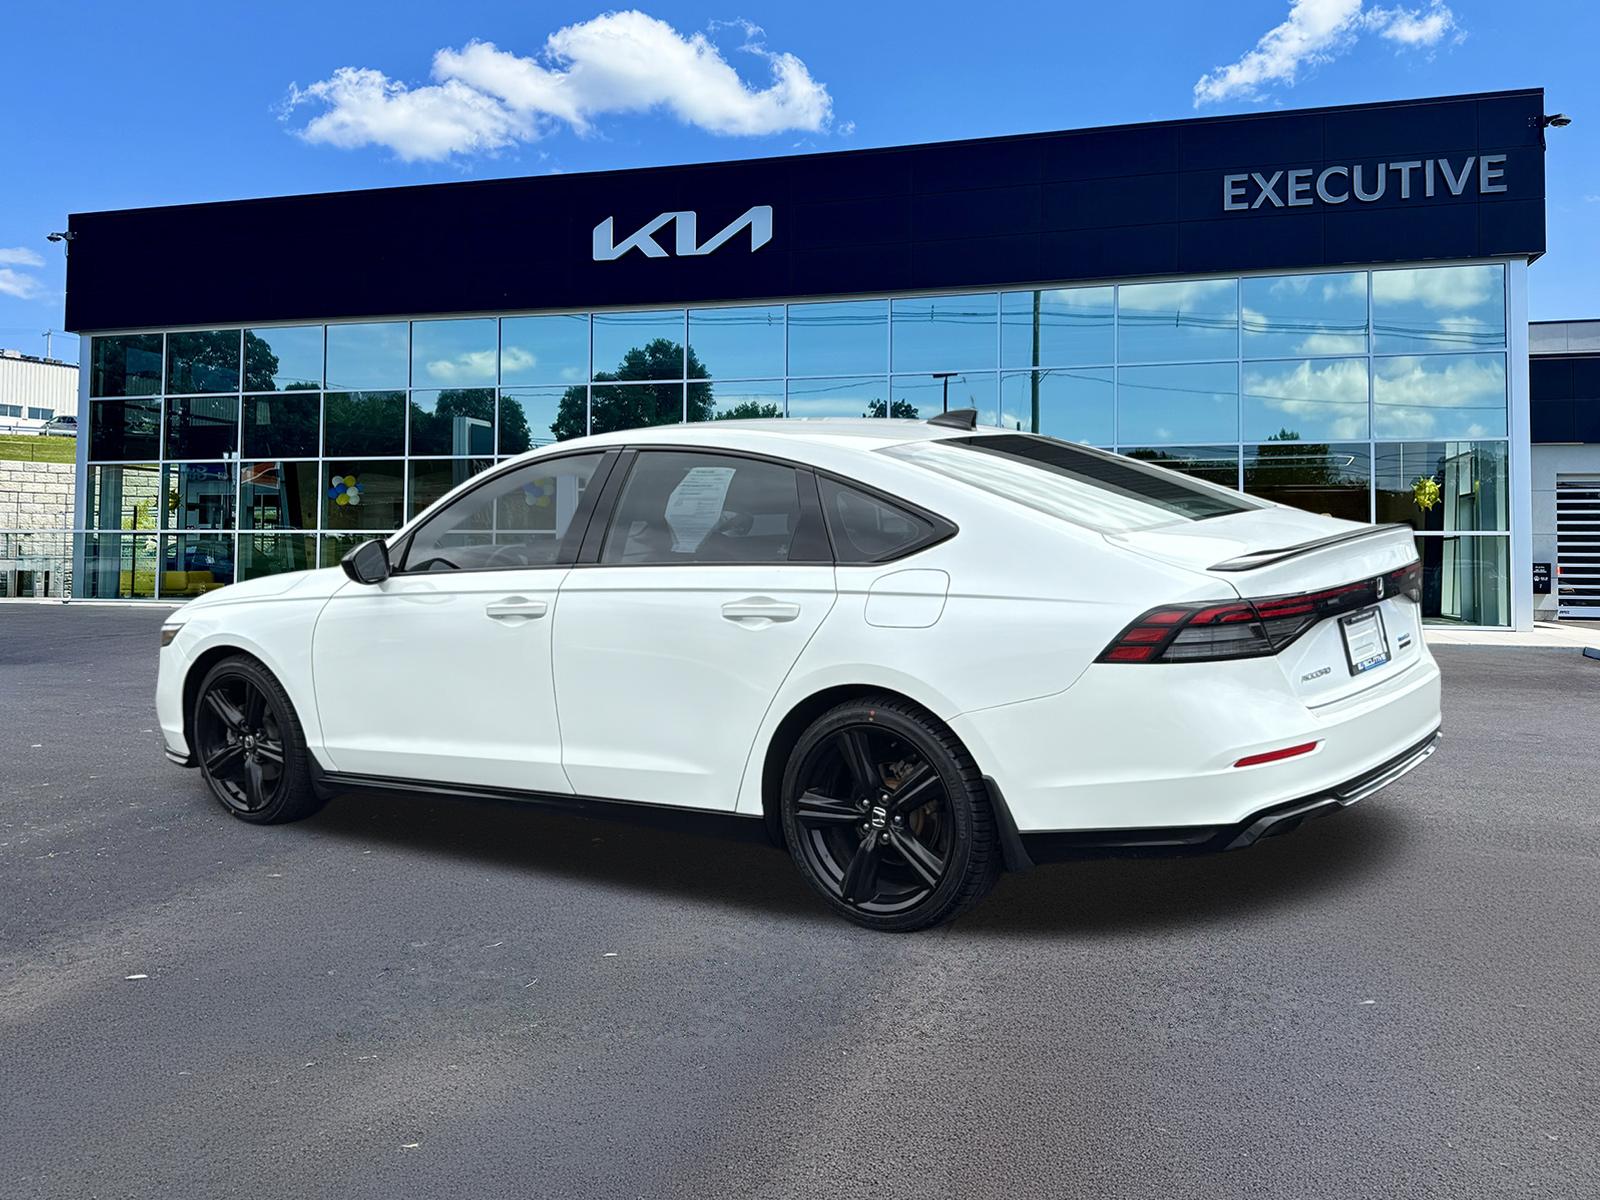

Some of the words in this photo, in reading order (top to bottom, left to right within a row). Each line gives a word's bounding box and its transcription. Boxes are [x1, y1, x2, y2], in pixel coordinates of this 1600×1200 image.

[1223, 154, 1508, 211] EXECUTIVE
[592, 205, 773, 261] KIA
[1301, 667, 1332, 683] ACCORD
